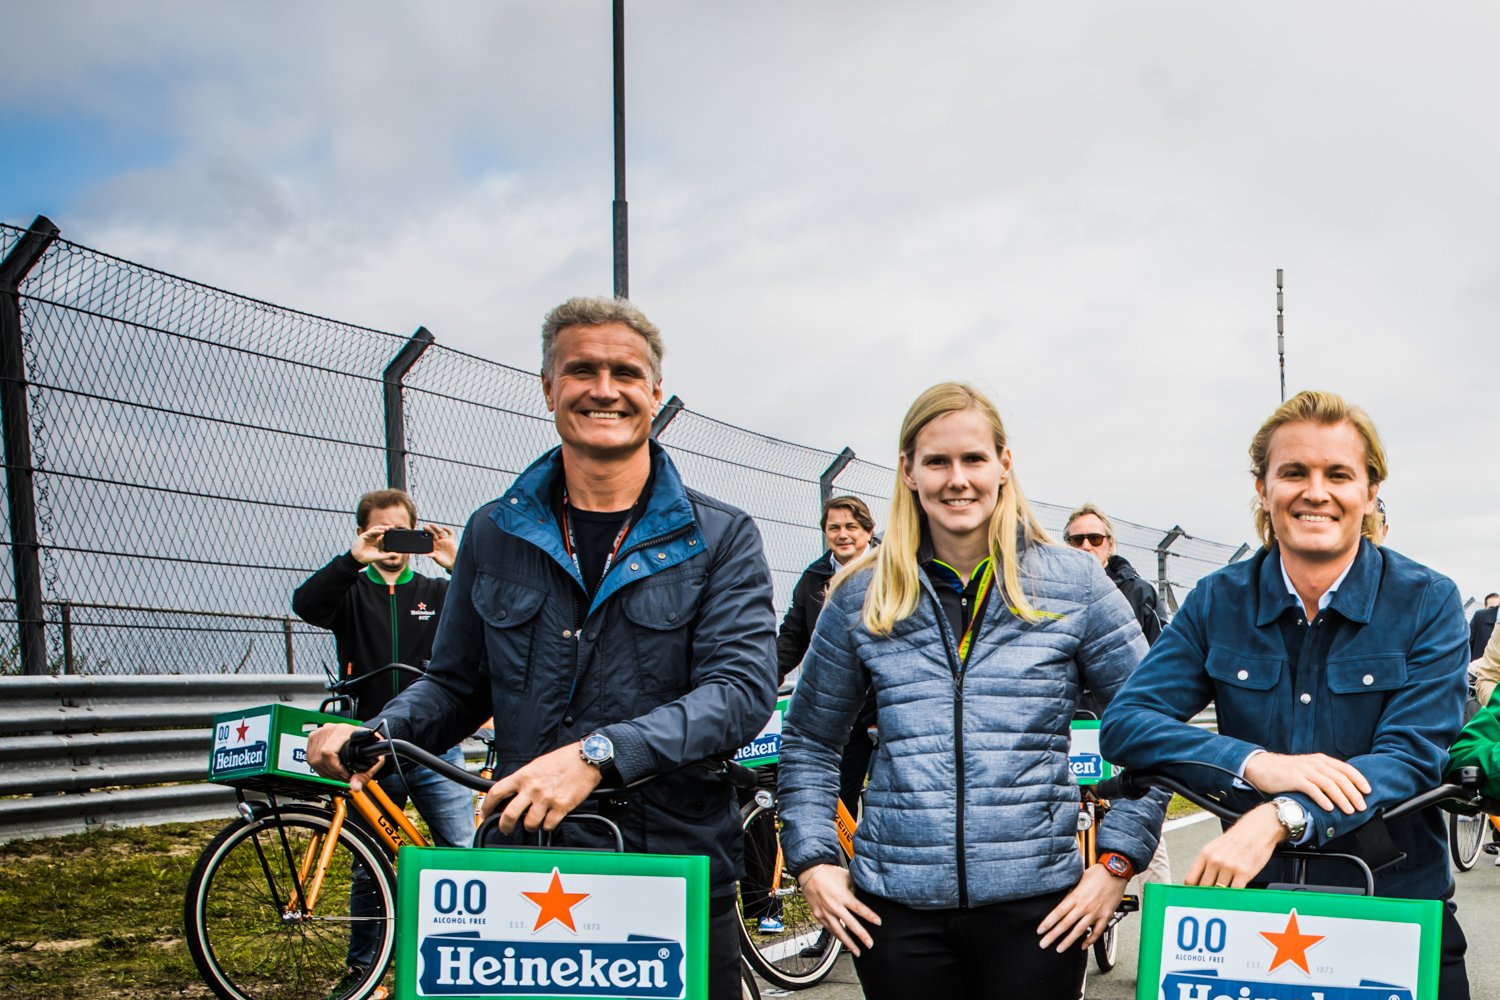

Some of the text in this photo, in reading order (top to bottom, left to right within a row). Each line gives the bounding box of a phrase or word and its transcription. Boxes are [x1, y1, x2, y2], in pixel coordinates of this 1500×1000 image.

[434, 878, 487, 915] 0.0
[433, 917, 466, 925] ALCOHOL
[509, 921, 600, 931] EST. 1873
[1177, 916, 1227, 954] 0.0
[1175, 954, 1225, 964] ALCOHOL FREE
[1246, 961, 1334, 974] EST. 1873
